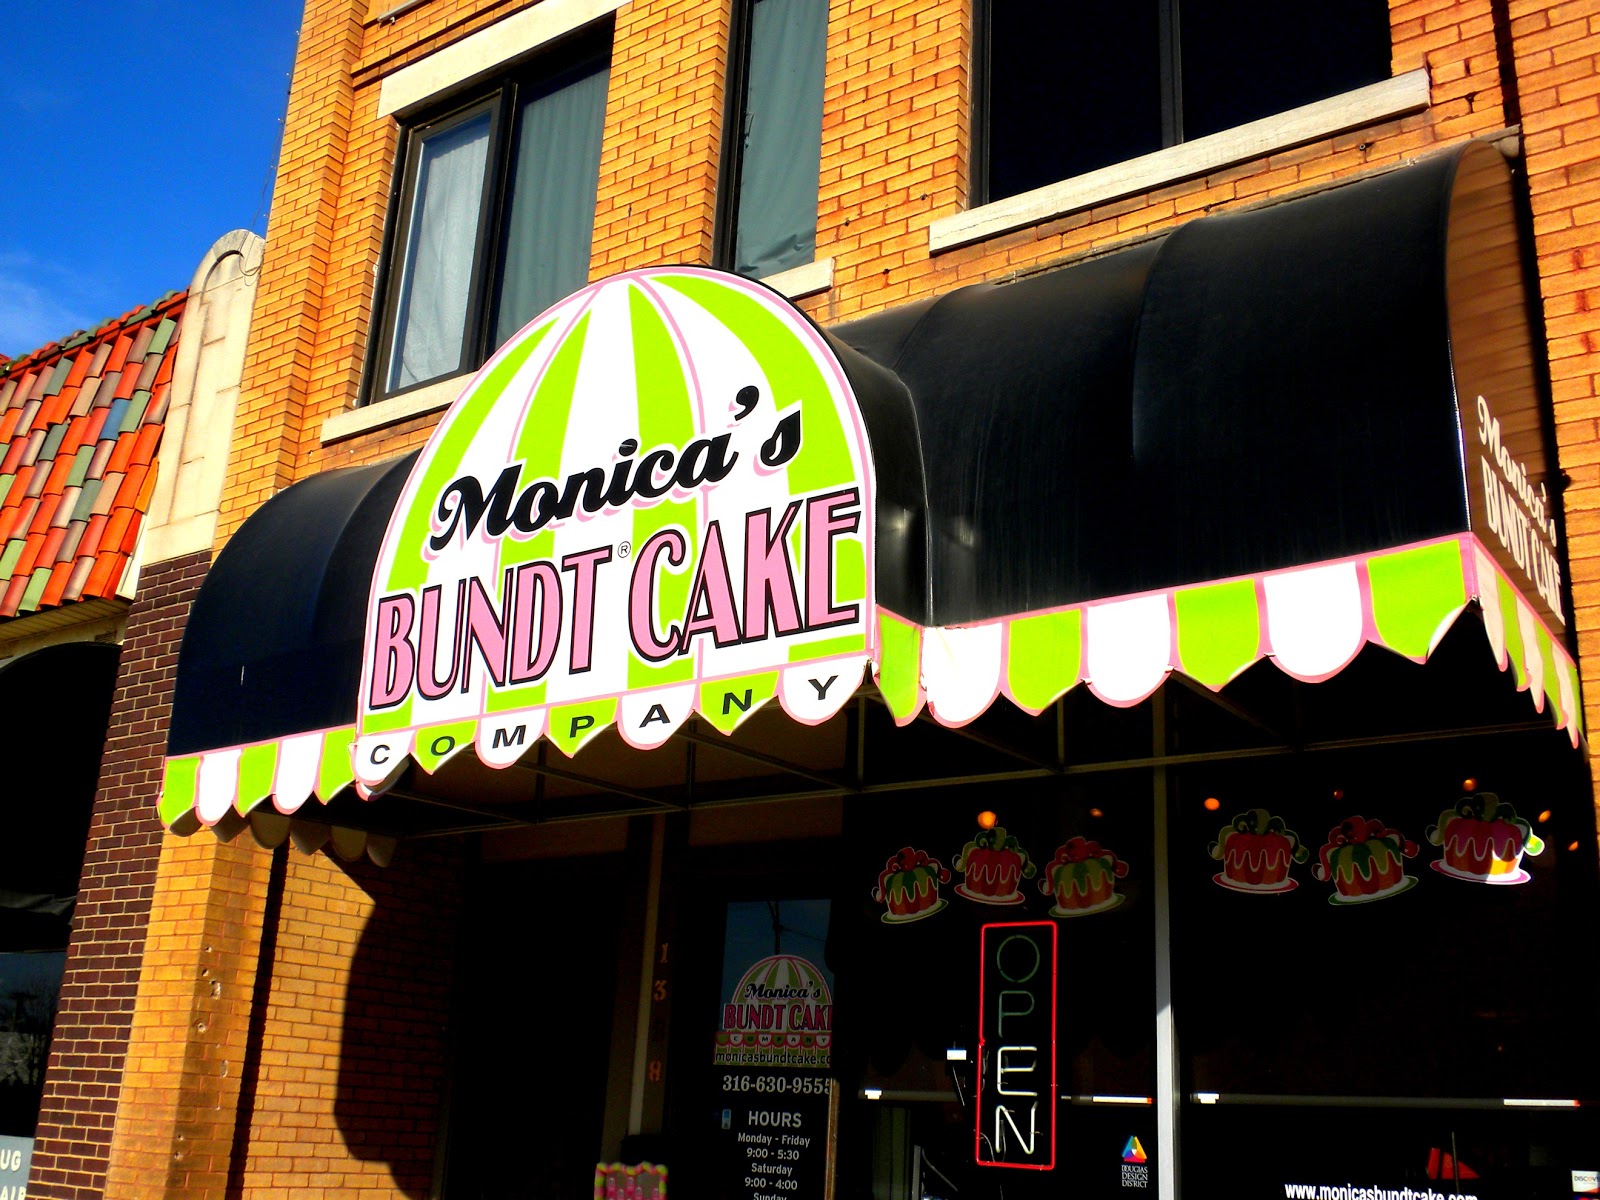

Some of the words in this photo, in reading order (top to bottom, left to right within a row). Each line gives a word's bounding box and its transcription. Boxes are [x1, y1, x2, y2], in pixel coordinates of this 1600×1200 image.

[428, 385, 801, 554] Monica's
[1477, 394, 1557, 548] Monica's
[1481, 454, 1532, 582] BUNDT
[1530, 527, 1566, 627] CAKE
[368, 543, 613, 711] BUNDT
[627, 486, 862, 663] CAKE
[369, 674, 840, 767] COMPANY
[744, 981, 821, 998] Monica's
[723, 1003, 787, 1030] BUNDT
[996, 934, 1041, 1155] OPEN
[748, 1110, 802, 1128] HOURS
[737, 1132, 773, 1146] Monday
[781, 1134, 811, 1148] Friday
[746, 1147, 769, 1159] 9:00
[777, 1149, 800, 1161] 5:30
[751, 1162, 793, 1177] Saturday
[1121, 1165, 1148, 1174] DOUGLAS
[1121, 1173, 1148, 1182] DESIGN
[744, 1176, 767, 1188] 9:00
[775, 1179, 798, 1190] 4:00
[1284, 1183, 1479, 1200] www.monicasbundtcake
